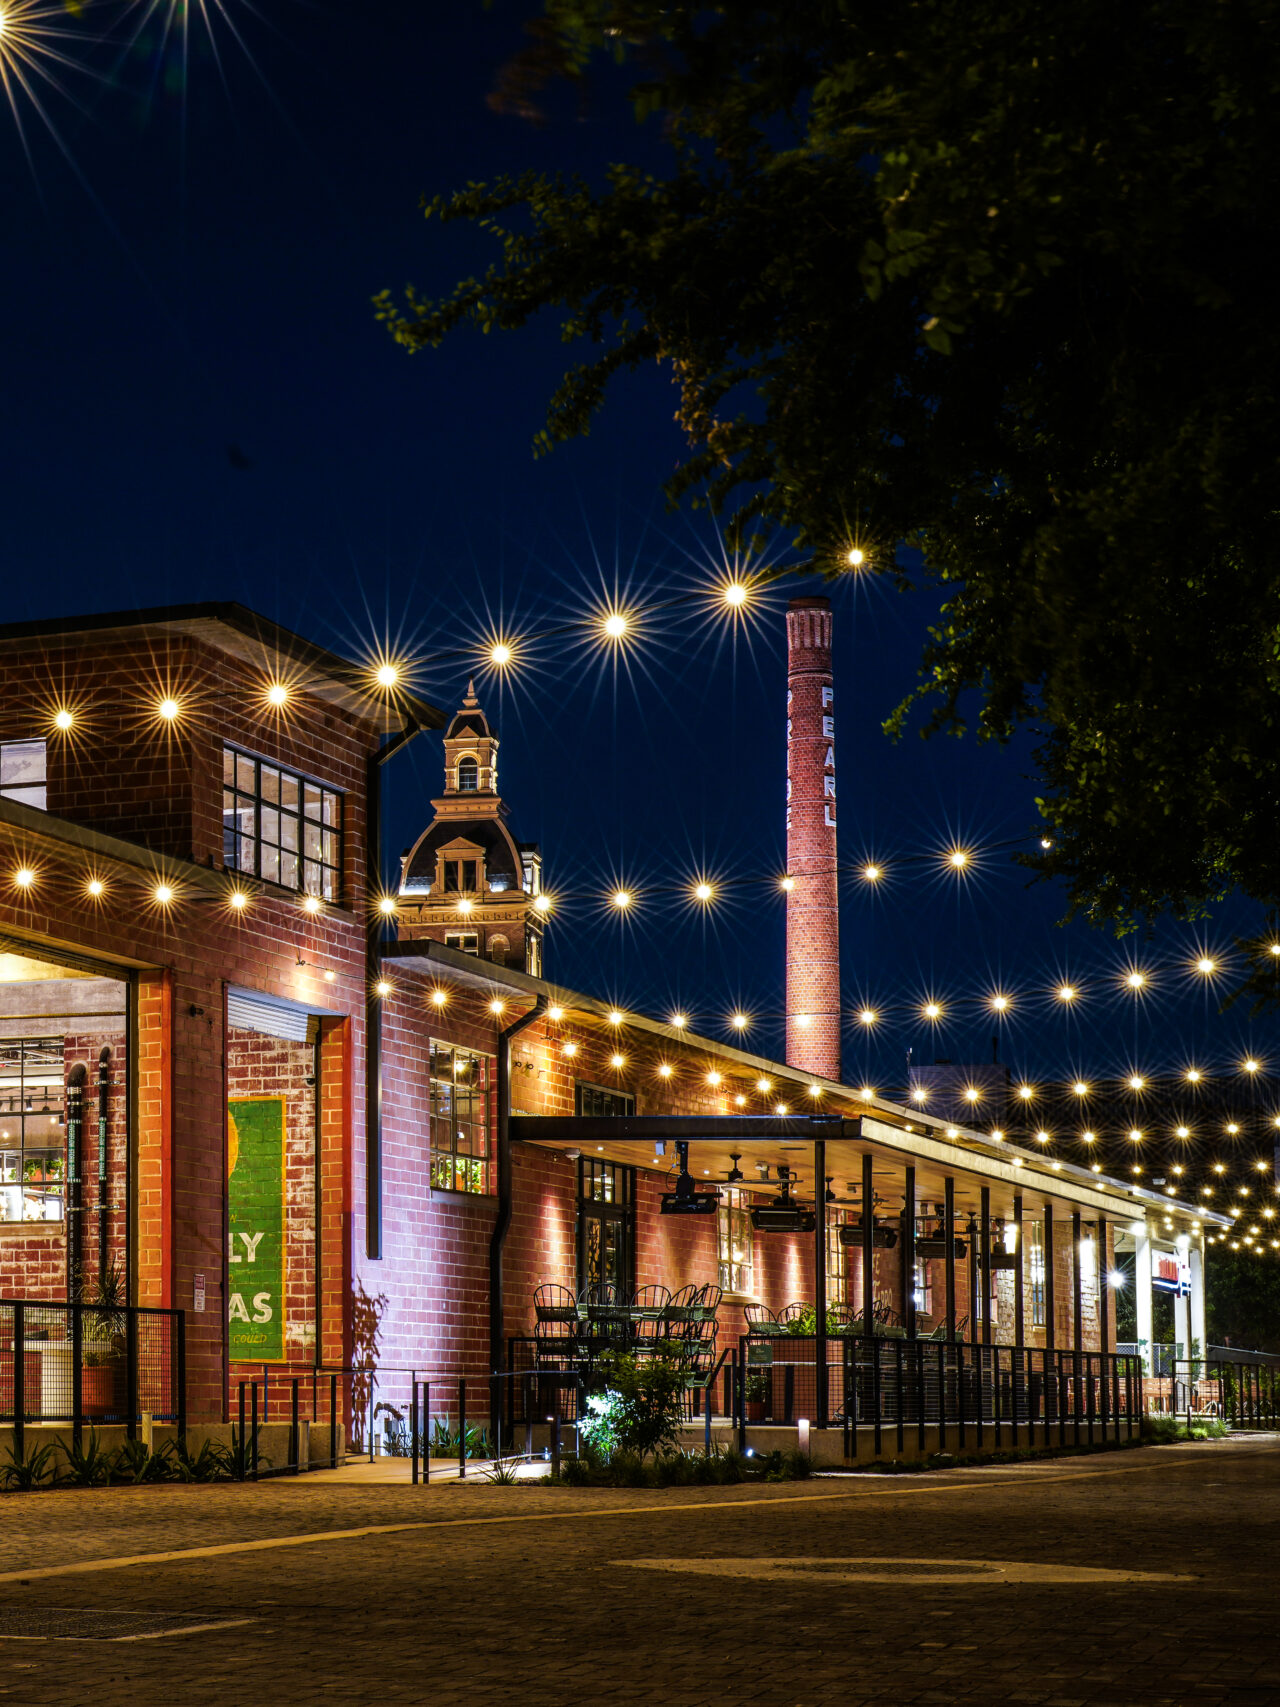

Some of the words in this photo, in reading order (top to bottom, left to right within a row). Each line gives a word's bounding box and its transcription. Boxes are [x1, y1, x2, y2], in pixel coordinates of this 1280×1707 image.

[822, 686, 837, 828] PEARL
[228, 1232, 265, 1263] LY
[228, 1292, 273, 1324] AS
